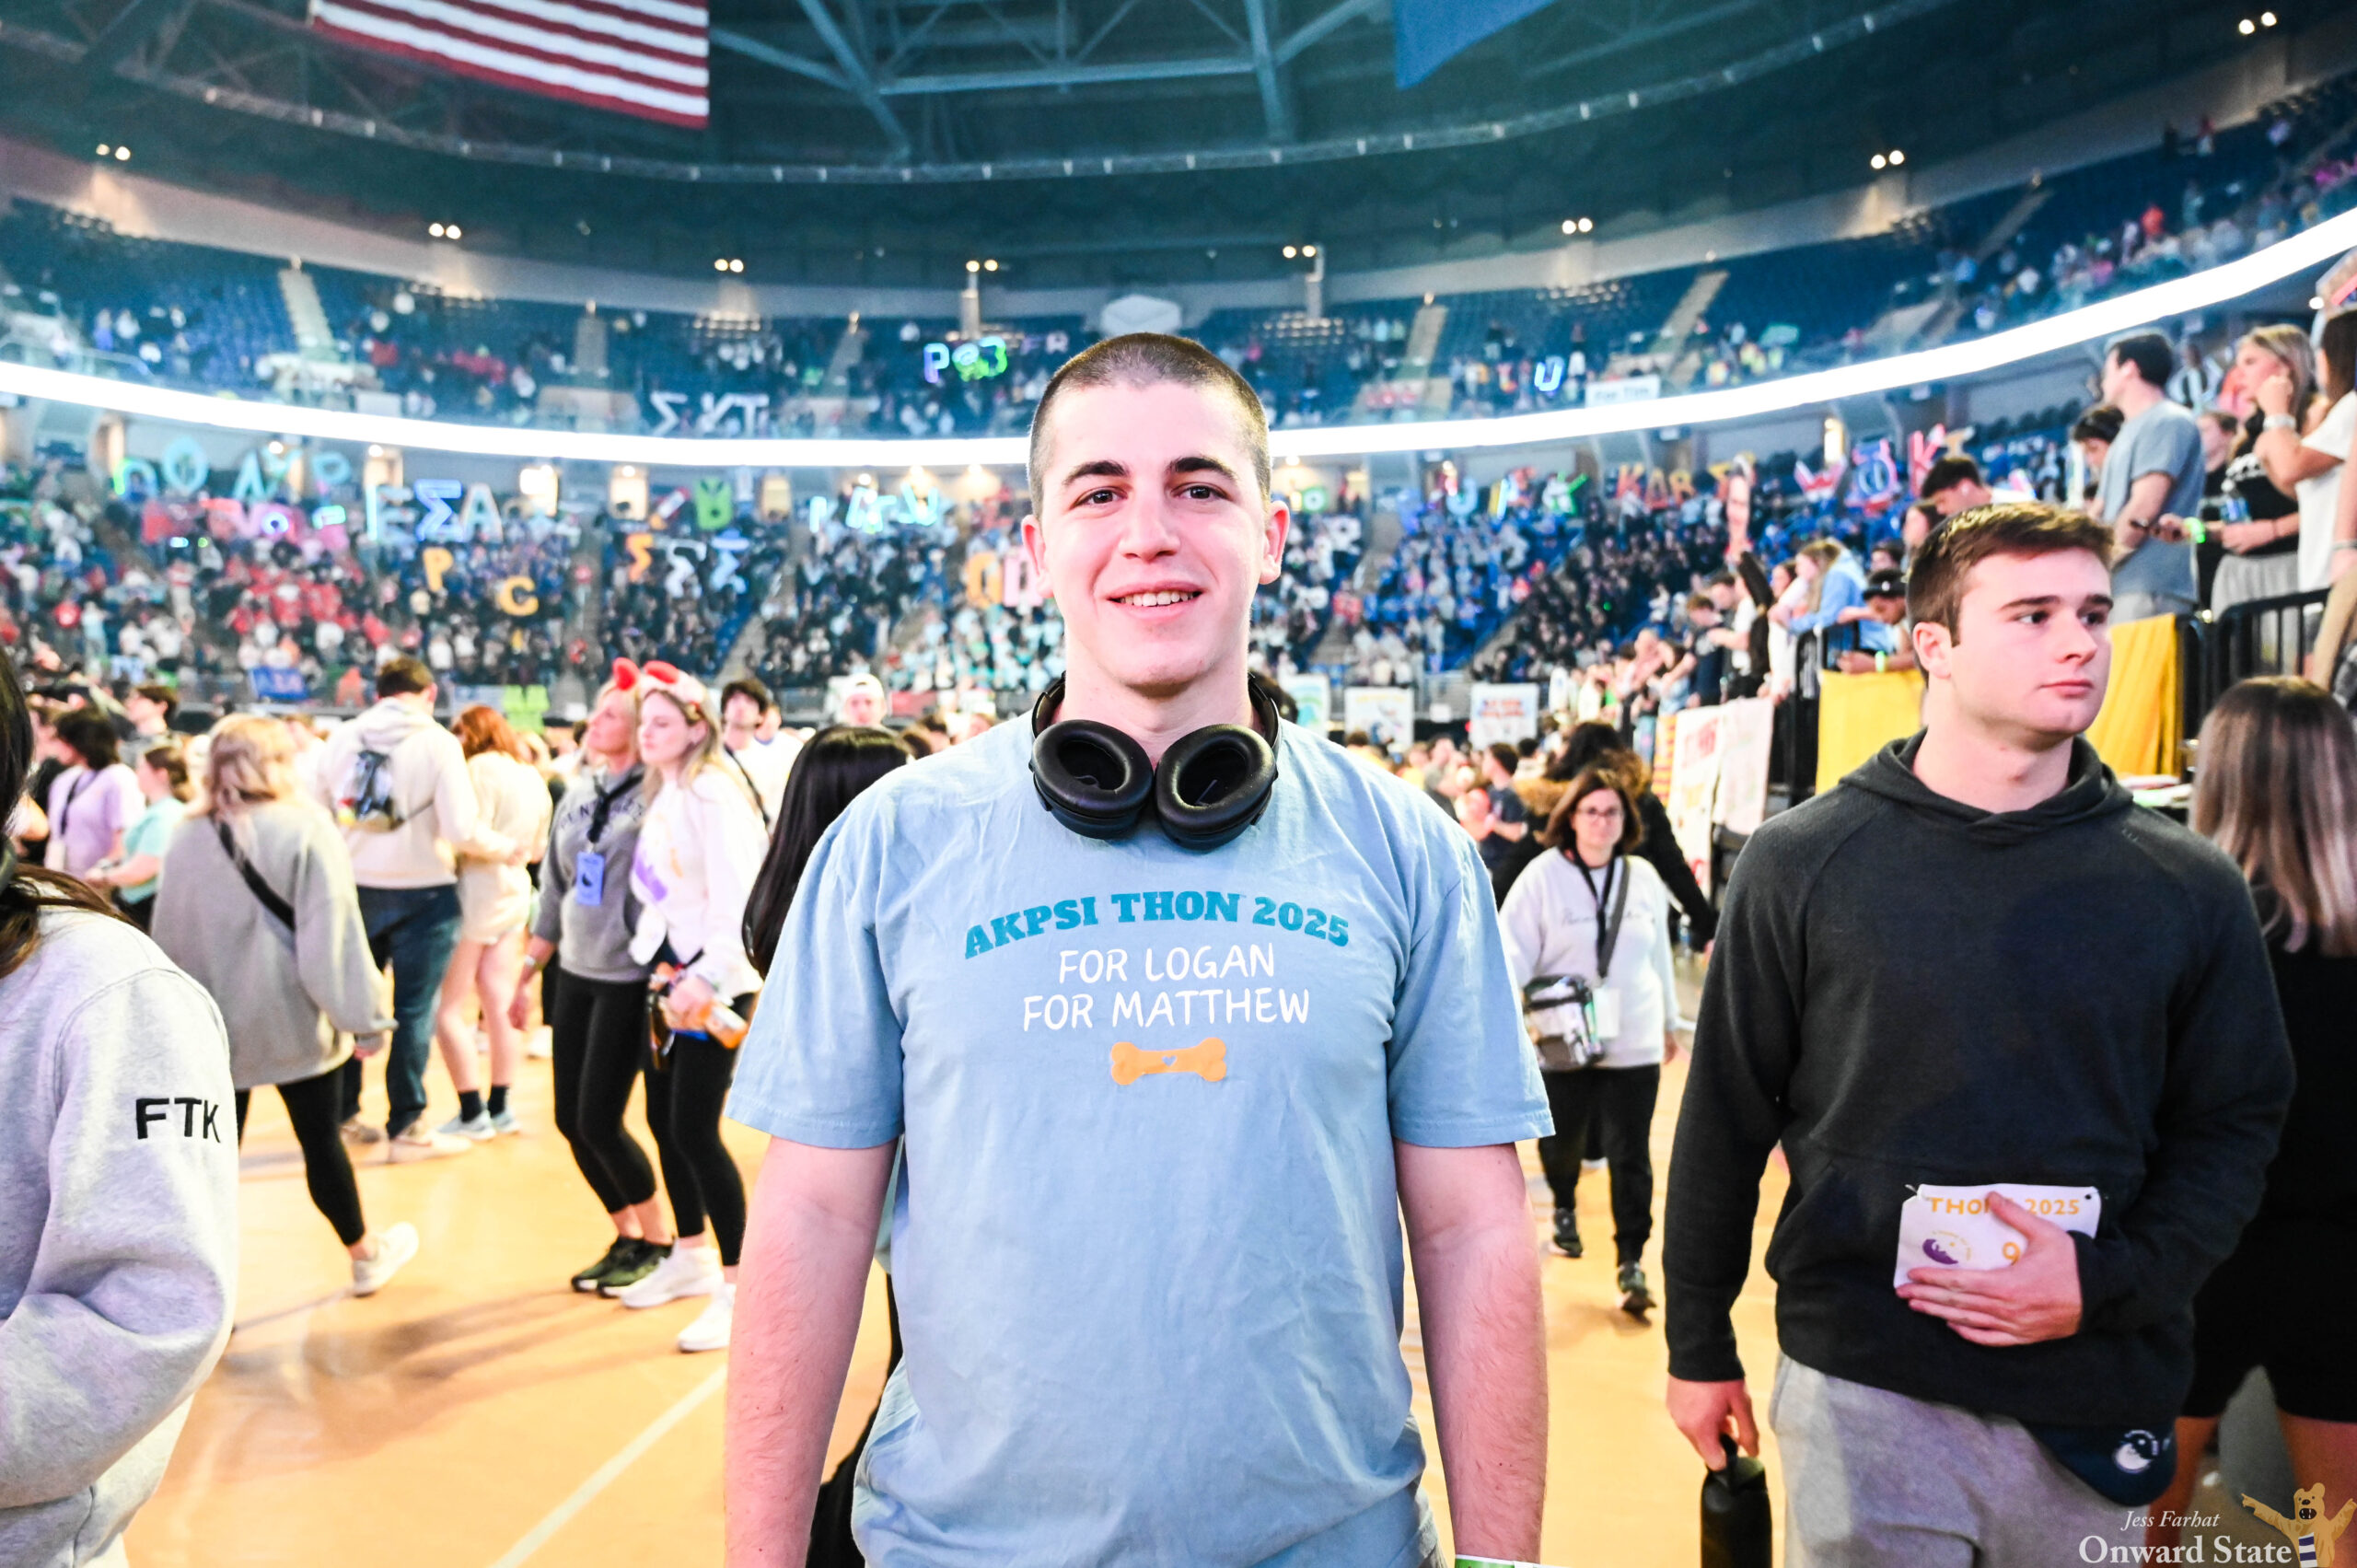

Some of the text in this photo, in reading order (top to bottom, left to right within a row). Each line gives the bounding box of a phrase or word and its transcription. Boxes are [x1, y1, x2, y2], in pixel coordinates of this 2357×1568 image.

[965, 890, 1350, 959] AKPSI THON 2025
[1058, 943, 1275, 984] FOR LOGAN
[1023, 987, 1310, 1032] FOR MATTHEW
[136, 1098, 221, 1144] FTK
[2025, 1199, 2080, 1215] 2025
